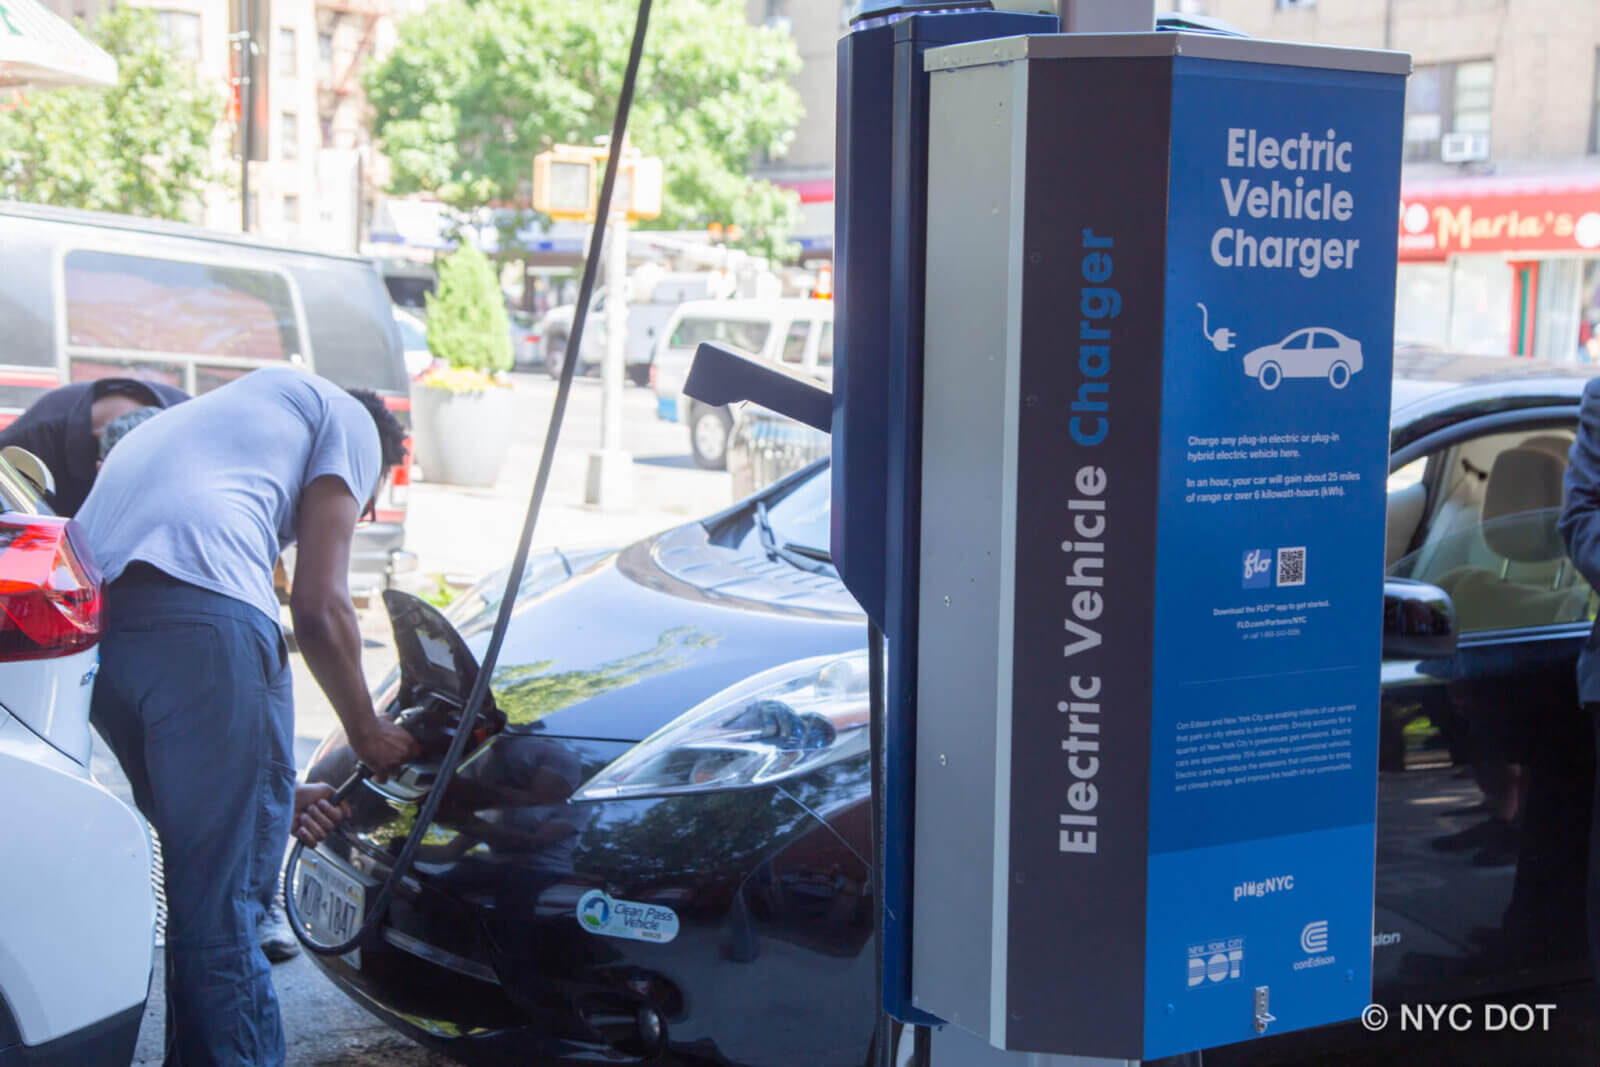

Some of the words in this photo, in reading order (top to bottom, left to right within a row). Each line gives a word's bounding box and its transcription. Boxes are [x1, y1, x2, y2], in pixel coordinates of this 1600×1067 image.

[1227, 128, 1352, 173] Electric
[1220, 176, 1354, 221] Vehicle
[1211, 227, 1360, 278] Charger
[1069, 228, 1122, 446] Charger
[1188, 436, 1219, 447] Charge
[1221, 437, 1237, 447] any
[1238, 435, 1268, 446] plug-in
[1269, 434, 1299, 443] electric
[1311, 432, 1339, 444] plug-in
[1187, 451, 1215, 462] hybrid
[1216, 450, 1248, 459] electric
[1250, 448, 1278, 458] vehicle
[1280, 448, 1300, 457] here.
[1187, 478, 1196, 488] In
[1233, 478, 1252, 488] your
[1253, 477, 1267, 485] car
[1269, 475, 1283, 484] will
[1284, 475, 1302, 485] gain
[1304, 473, 1327, 482] about
[1328, 472, 1338, 481] 25
[1339, 472, 1360, 480] miles
[1186, 493, 1196, 502] of
[1197, 494, 1222, 504] range
[1224, 493, 1233, 501] or
[1235, 492, 1252, 500] over
[1261, 488, 1320, 498] kilowatt-hours
[1061, 465, 1108, 656] Vehicle
[1244, 549, 1271, 579] flo
[1057, 676, 1101, 855] Electric
[1234, 875, 1294, 901] plugNYC
[615, 904, 643, 917] Clean
[645, 908, 674, 921] Pass
[624, 915, 660, 930] Vehicle
[1189, 951, 1243, 986] DOT
